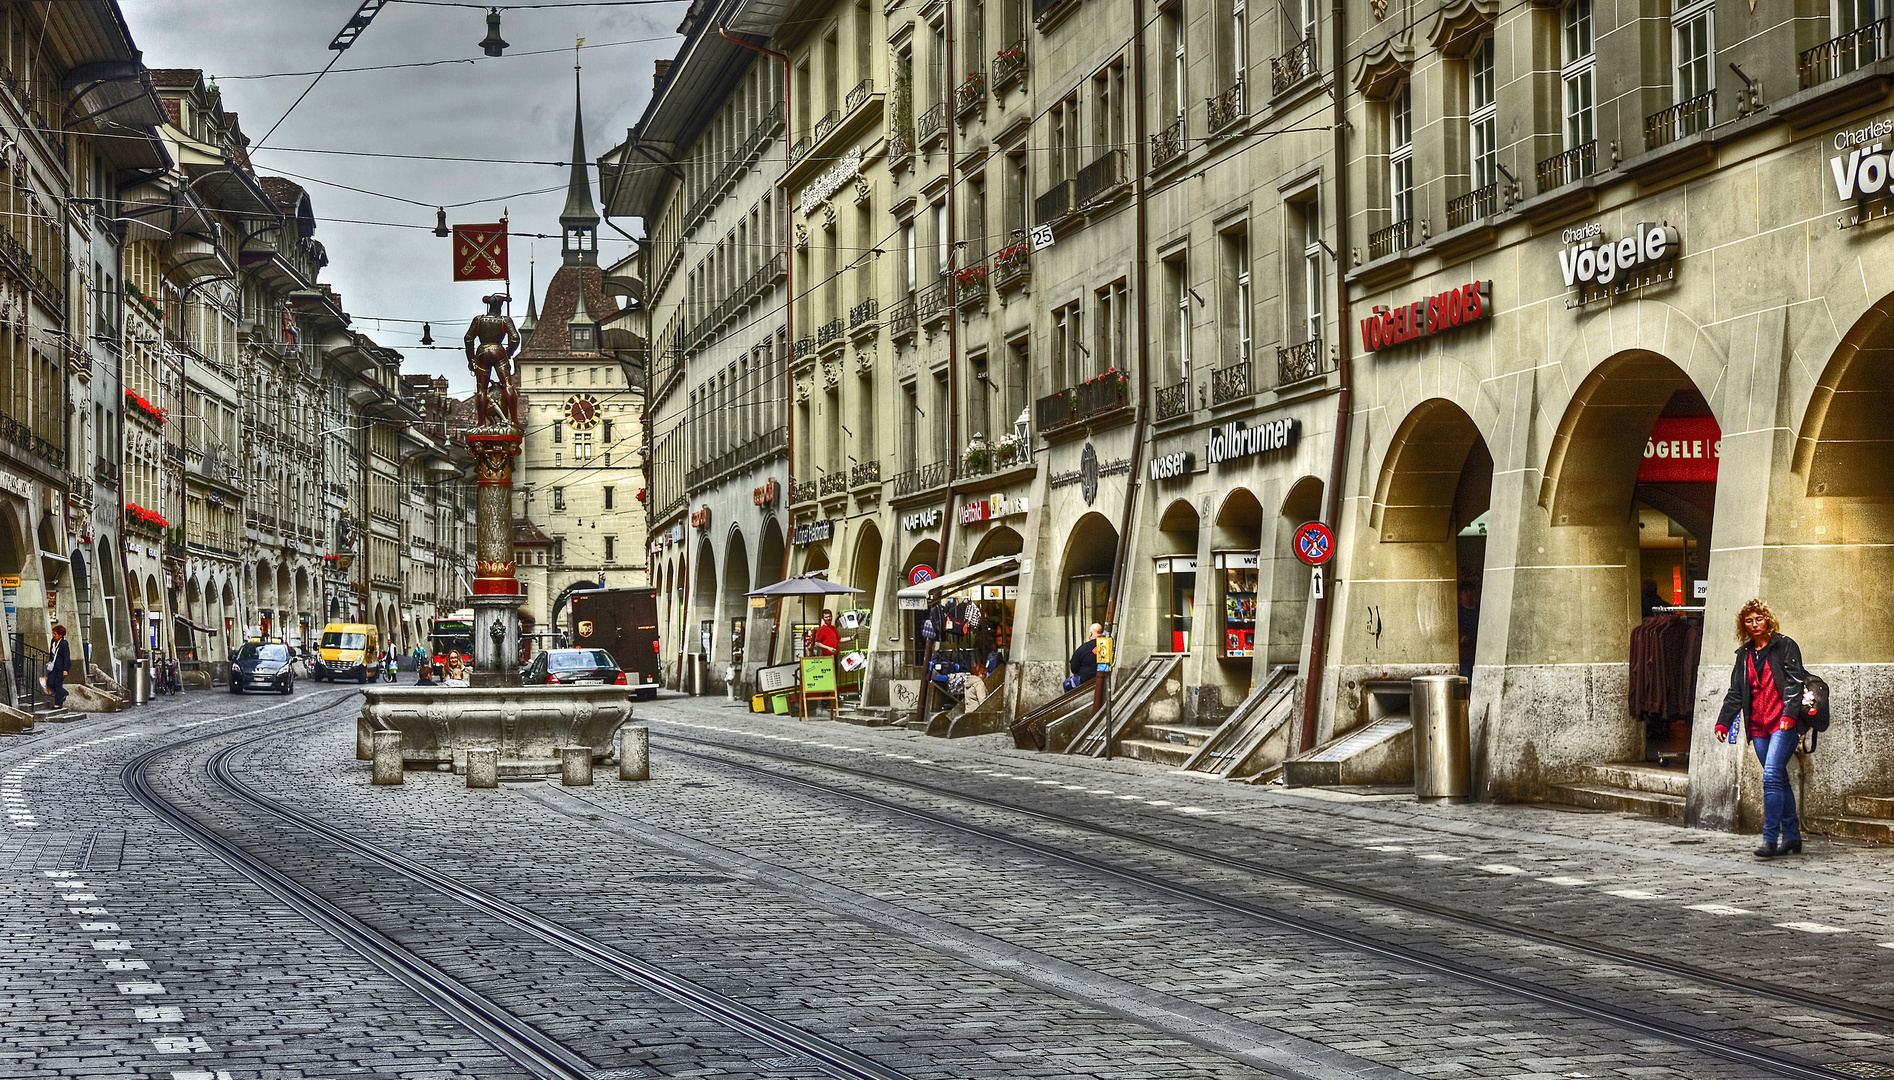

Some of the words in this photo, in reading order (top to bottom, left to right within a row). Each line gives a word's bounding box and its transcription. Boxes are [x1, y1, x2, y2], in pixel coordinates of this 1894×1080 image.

[1834, 119, 1893, 150] Charles
[1033, 229, 1052, 245] 25
[1562, 222, 1601, 244] Charles
[1559, 223, 1666, 286] Vögele
[1564, 268, 1673, 310] Switzerland
[1361, 302, 1419, 352] VÖGELE
[1429, 281, 1480, 332] SHOES
[1208, 417, 1292, 464] kollbrunner
[1150, 451, 1186, 480] waser
[959, 501, 981, 525] Weltbild
